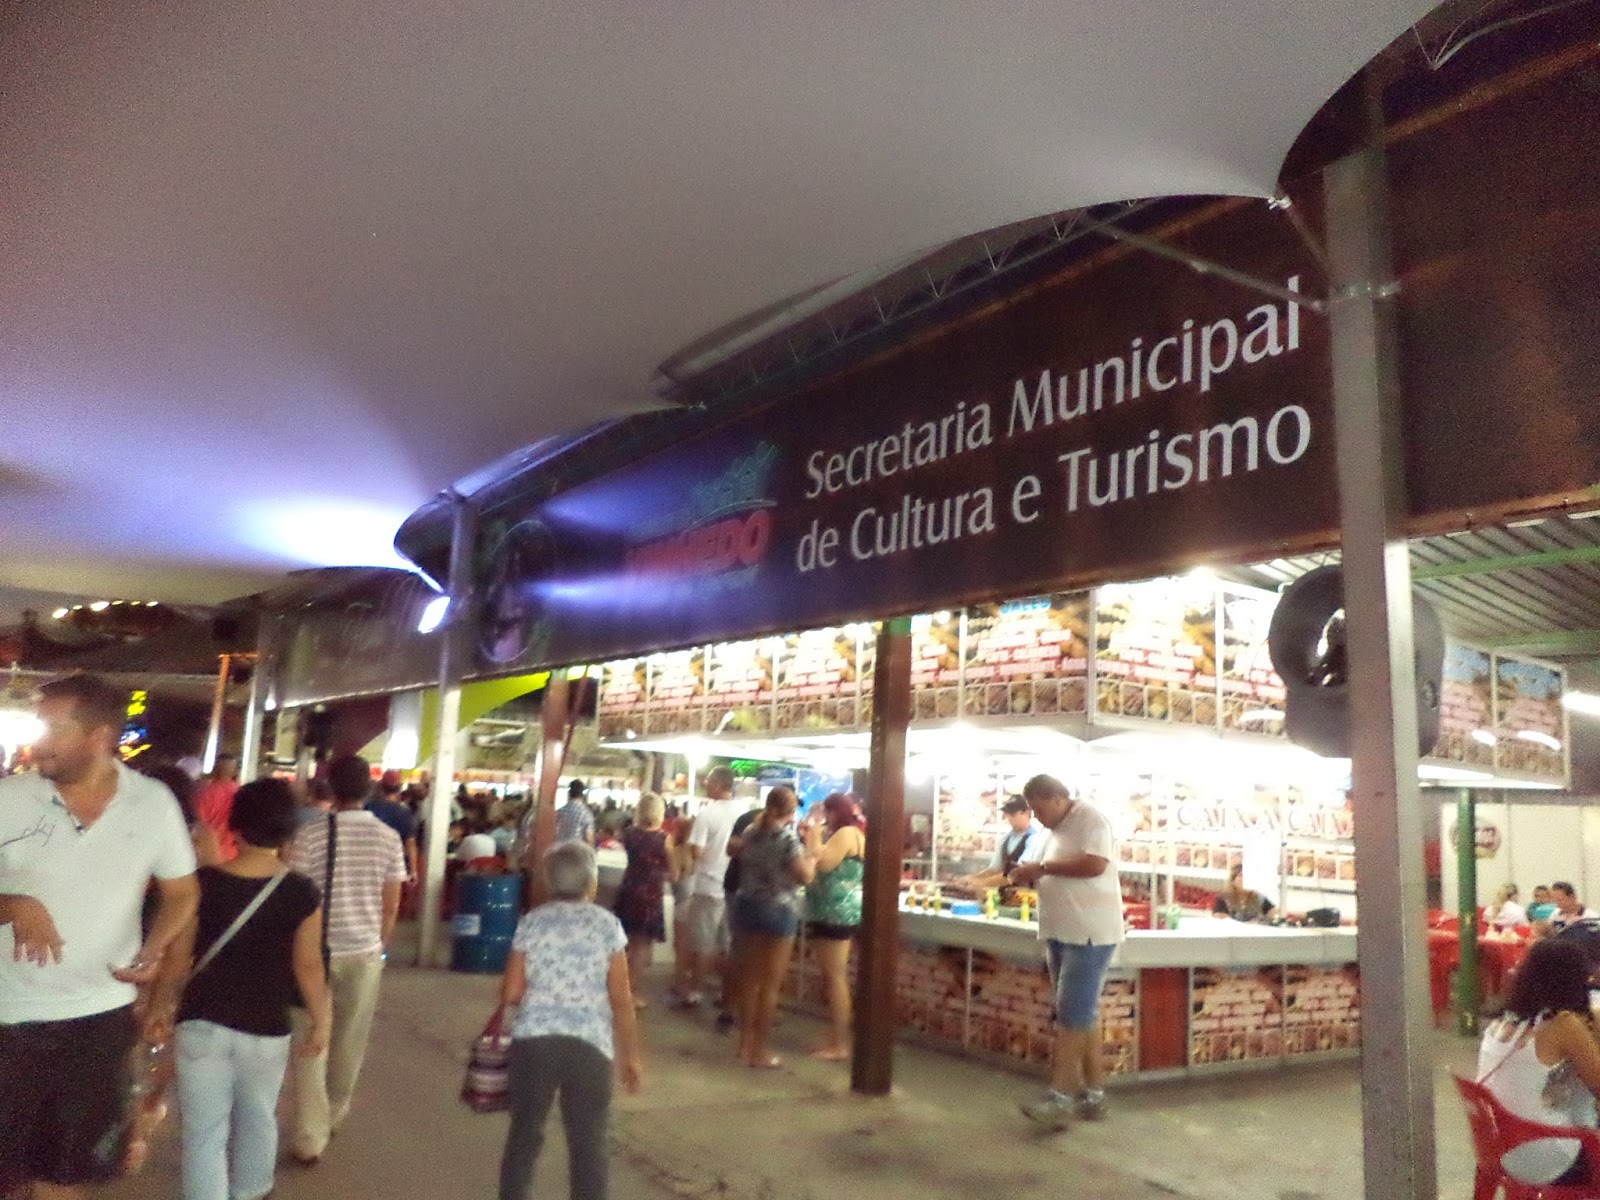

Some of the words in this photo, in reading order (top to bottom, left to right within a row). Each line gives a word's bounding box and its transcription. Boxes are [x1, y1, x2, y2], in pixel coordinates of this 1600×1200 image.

[806, 401, 992, 499] Secretaria
[1007, 275, 1301, 438] Municipal
[796, 519, 839, 573] de
[849, 495, 996, 562] Cultura
[1012, 474, 1041, 524] e
[1058, 403, 1312, 512] Turismo
